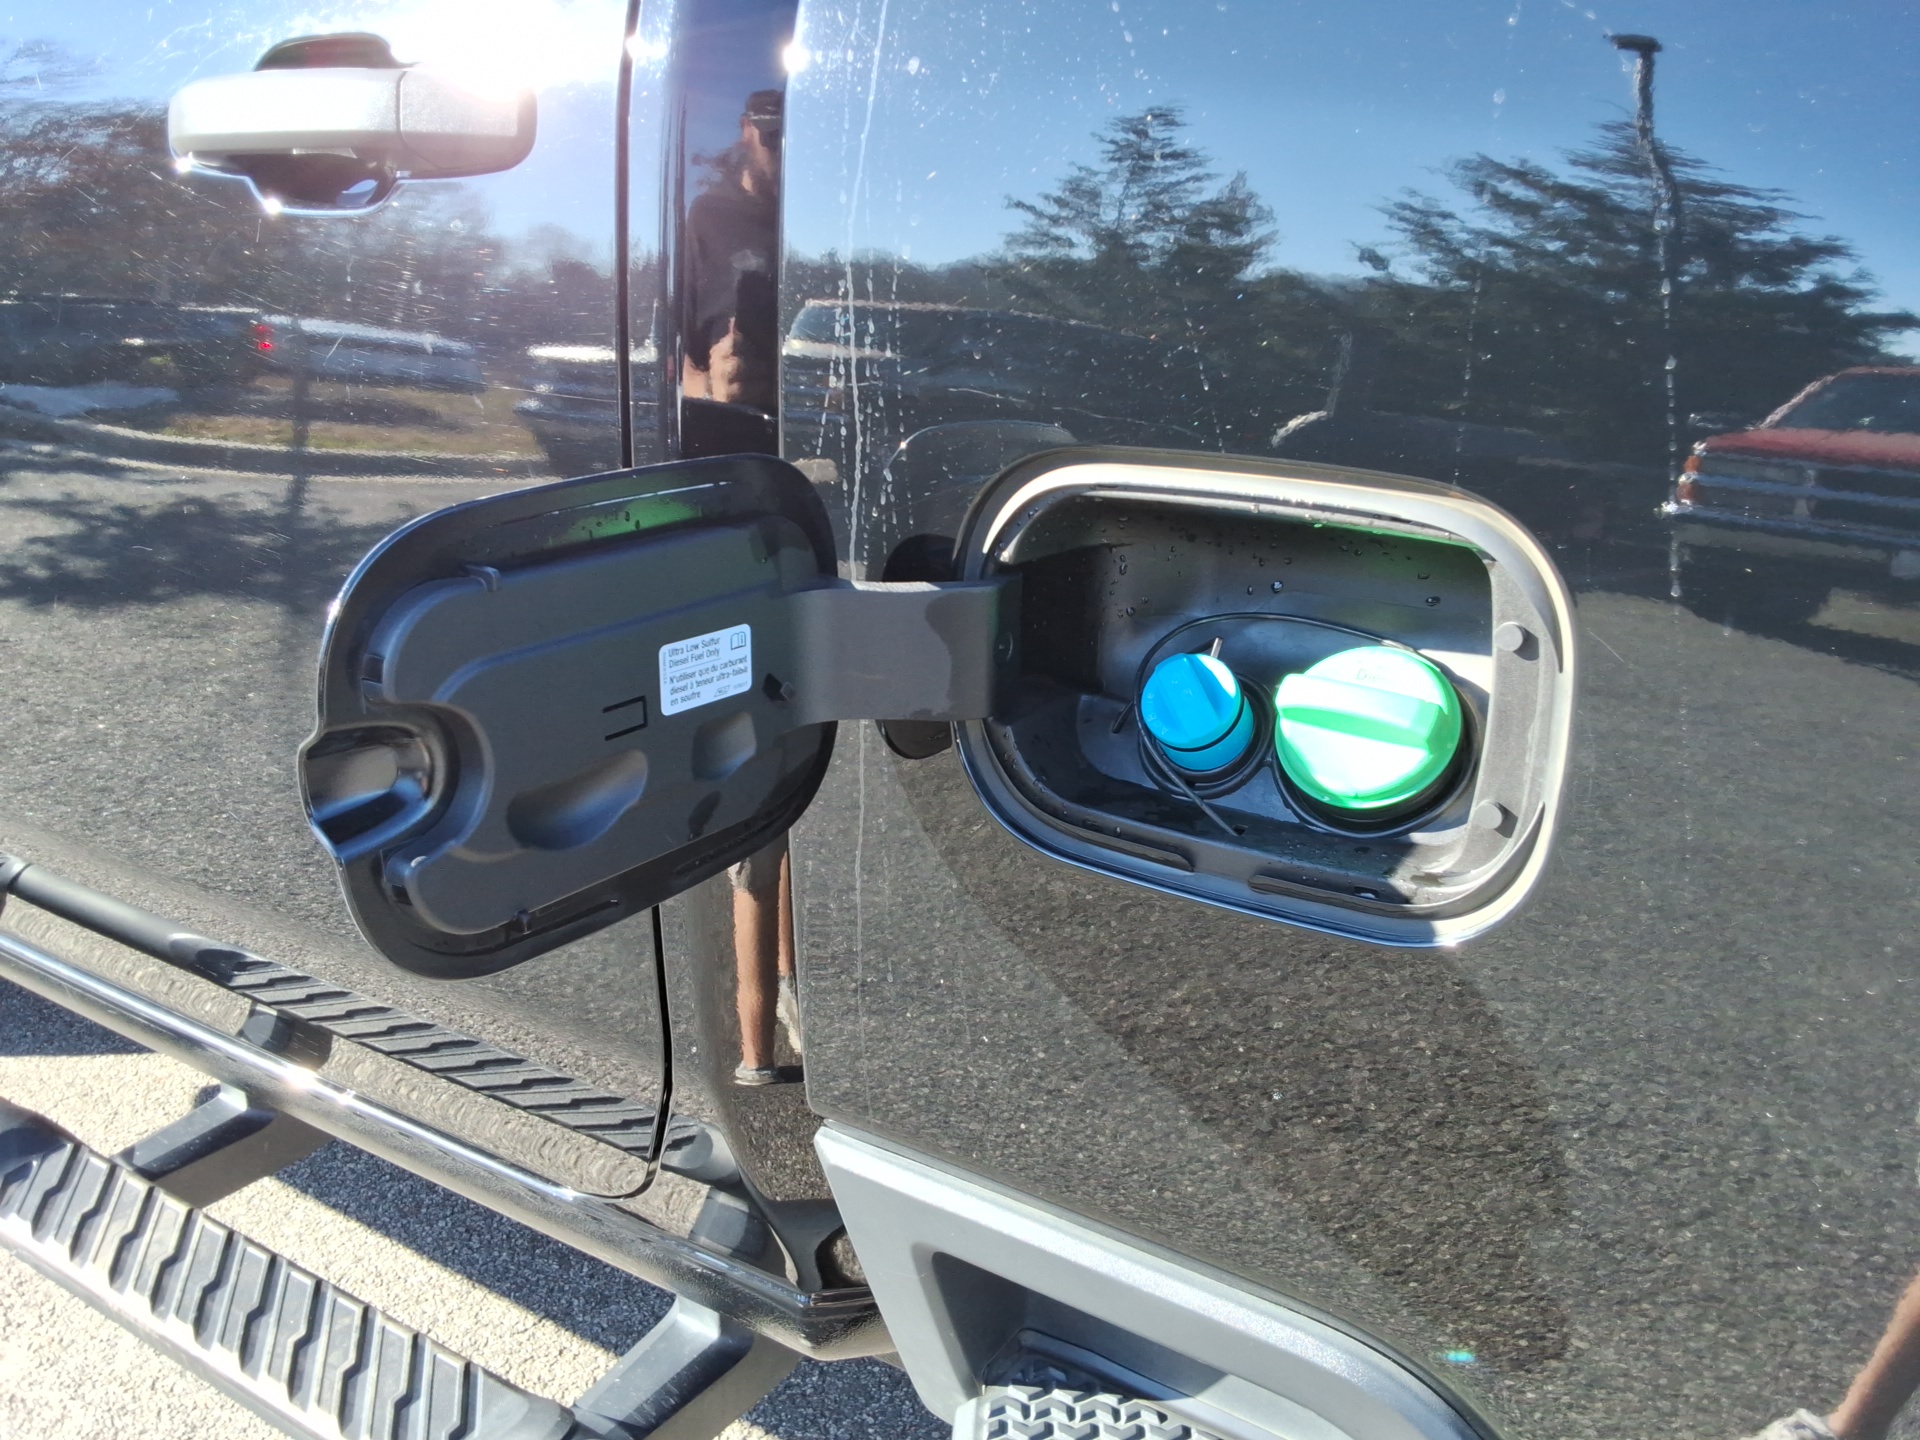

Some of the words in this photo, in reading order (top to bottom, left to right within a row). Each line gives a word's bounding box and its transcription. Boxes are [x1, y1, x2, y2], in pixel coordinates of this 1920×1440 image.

[668, 647, 684, 657] Ultra
[686, 643, 699, 653] Low
[701, 637, 721, 649] Sulfur
[669, 656, 689, 668] Diesel
[691, 652, 704, 663] Fuel
[706, 647, 720, 659] Only
[669, 671, 697, 684] N'utiliser
[698, 666, 710, 677] que
[711, 662, 719, 673] du
[719, 655, 747, 670] carburant
[670, 683, 689, 695] diesel
[695, 675, 715, 688] teneur
[670, 698, 679, 706] en
[680, 691, 701, 703] soufre
